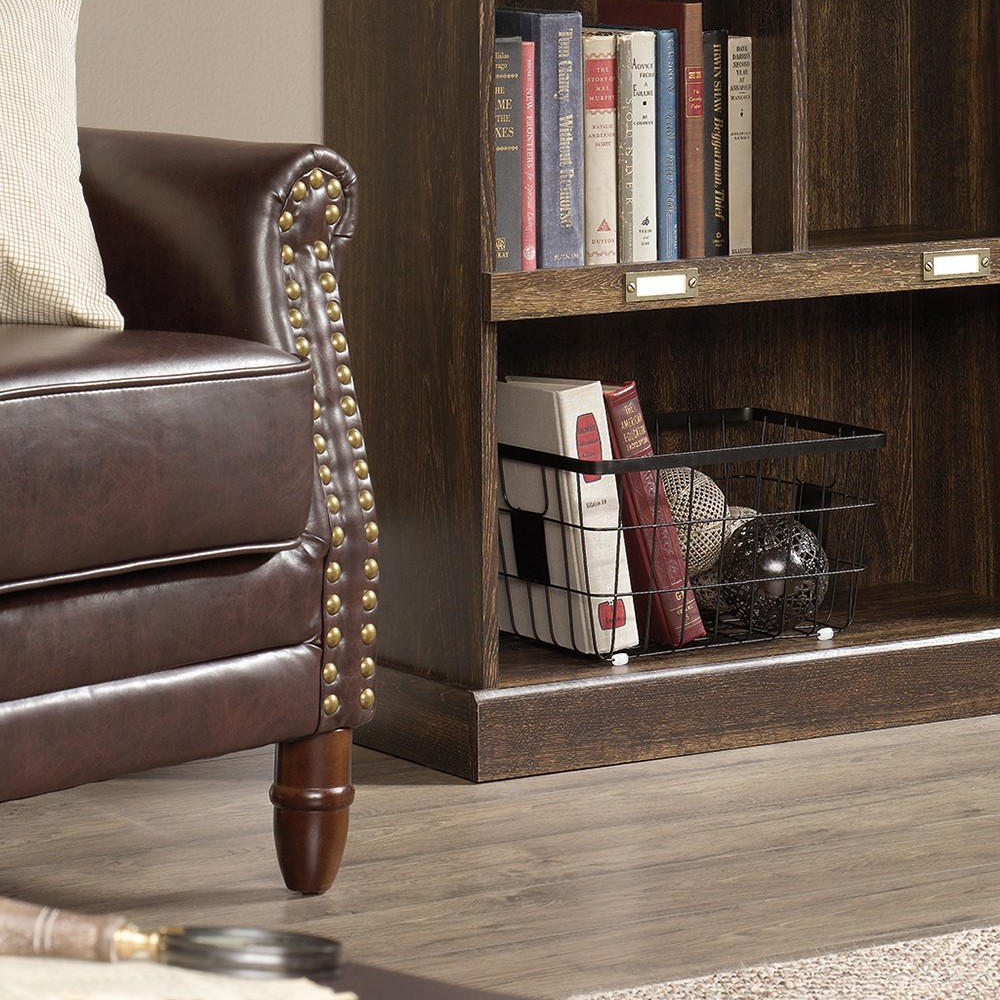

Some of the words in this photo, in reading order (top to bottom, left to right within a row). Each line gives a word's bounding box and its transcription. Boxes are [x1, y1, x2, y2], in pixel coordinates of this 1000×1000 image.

[558, 28, 573, 56] Tom
[631, 58, 653, 70] ADVICE
[713, 43, 722, 78] IRWIN
[735, 68, 749, 76] YEAR
[553, 60, 573, 102] Clancy
[495, 86, 505, 95] HE
[633, 84, 654, 97] FAILURE
[713, 80, 722, 112] SHAW
[496, 98, 513, 110] ME
[495, 126, 515, 138] XES
[559, 114, 574, 167] Without
[559, 168, 575, 228] Remorse
[553, 252, 580, 261] PUTNAM
[624, 402, 634, 415] THE
[620, 413, 643, 431] AMERICAN
[623, 425, 647, 443] EDUCATOR
